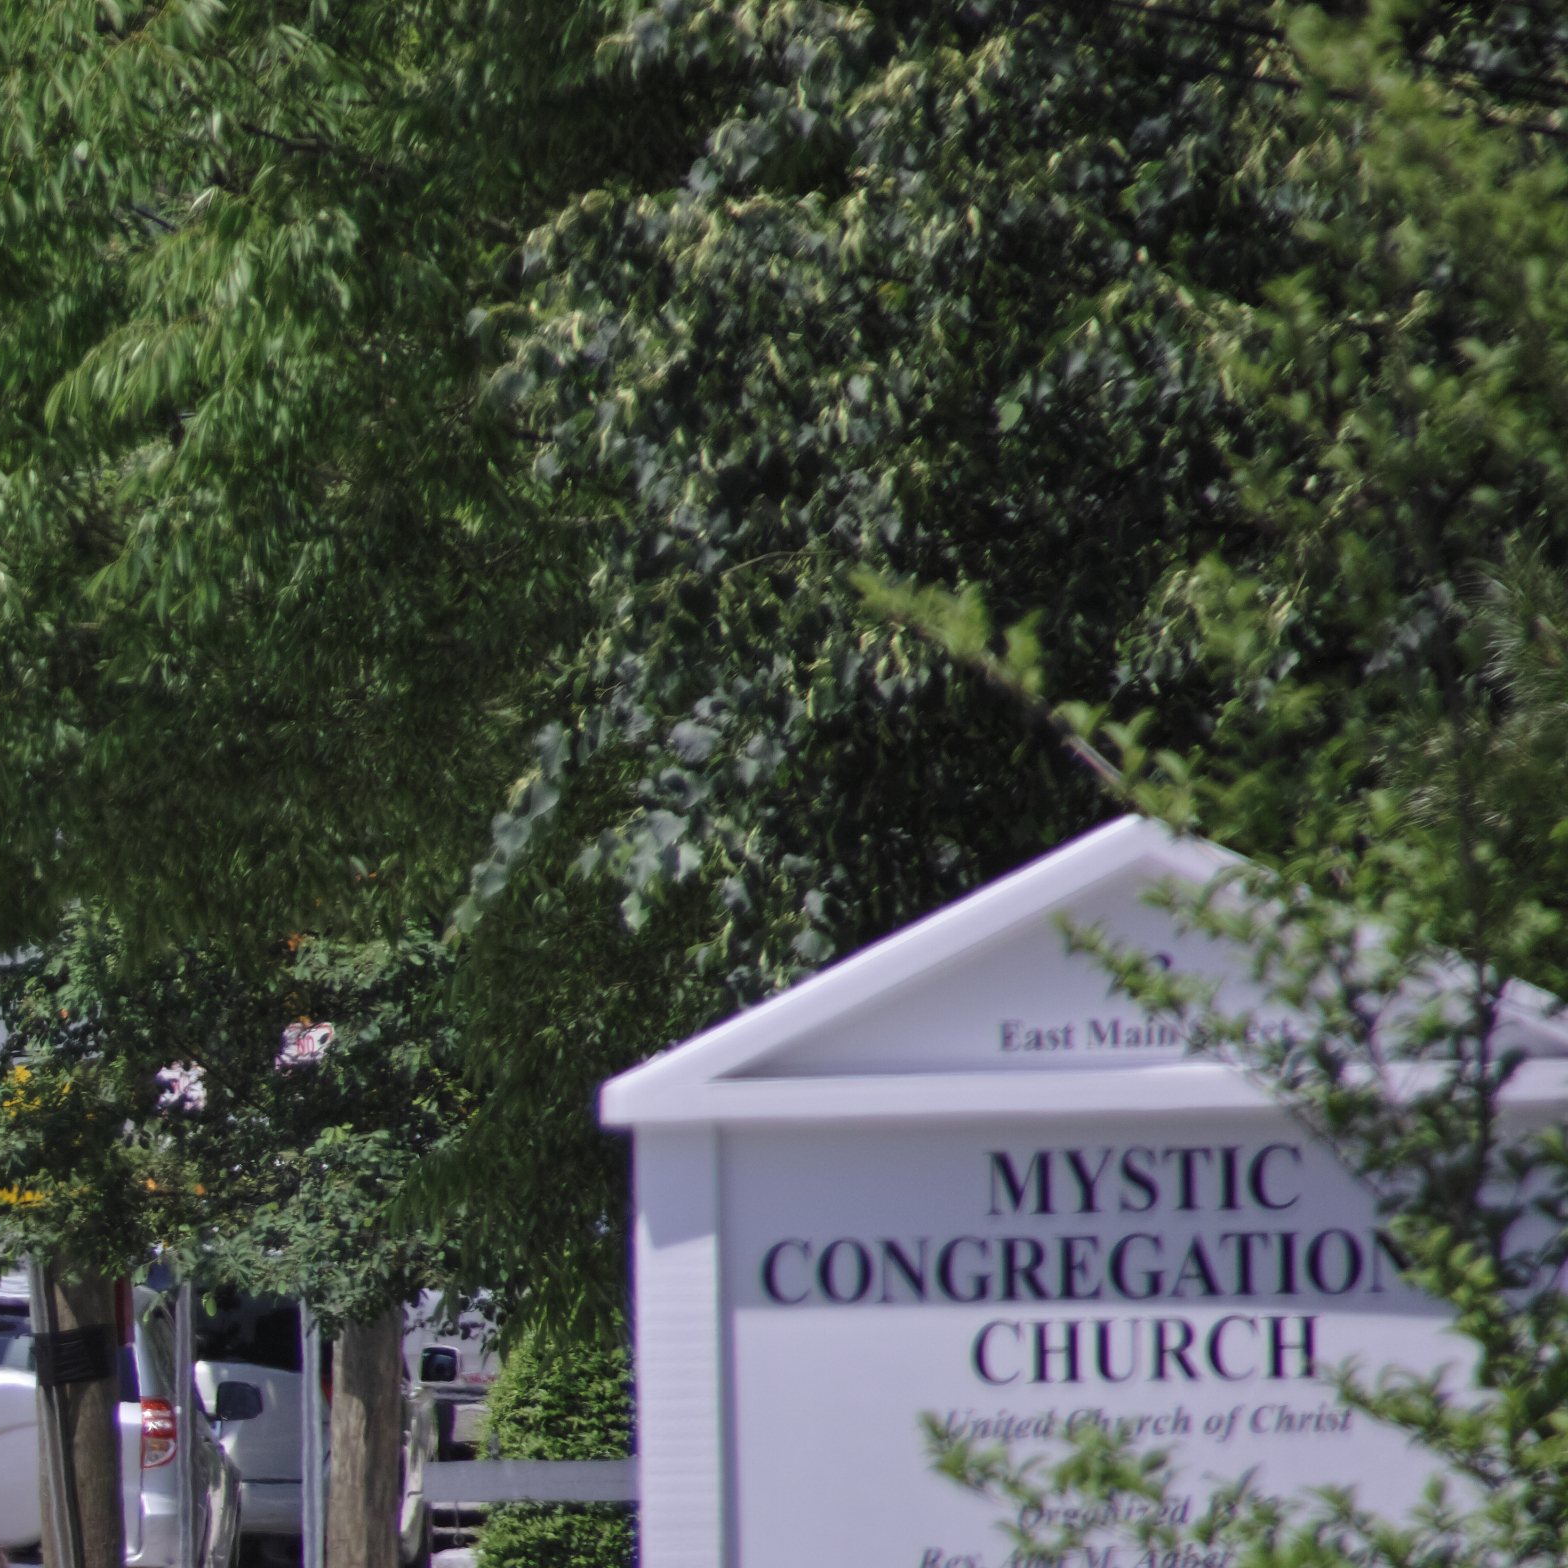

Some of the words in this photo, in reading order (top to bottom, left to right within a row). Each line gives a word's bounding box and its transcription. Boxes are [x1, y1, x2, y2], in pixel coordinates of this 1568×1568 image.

[999, 1018, 1075, 1051] East
[1086, 1016, 1181, 1049] Main
[985, 1143, 1303, 1216] MYSTIC
[761, 1228, 1411, 1306] CONGREGATION
[971, 1314, 1320, 1386] CHURCH
[943, 1408, 1054, 1440] United
[1204, 1405, 1240, 1442] of
[1250, 1402, 1354, 1435] Christ
